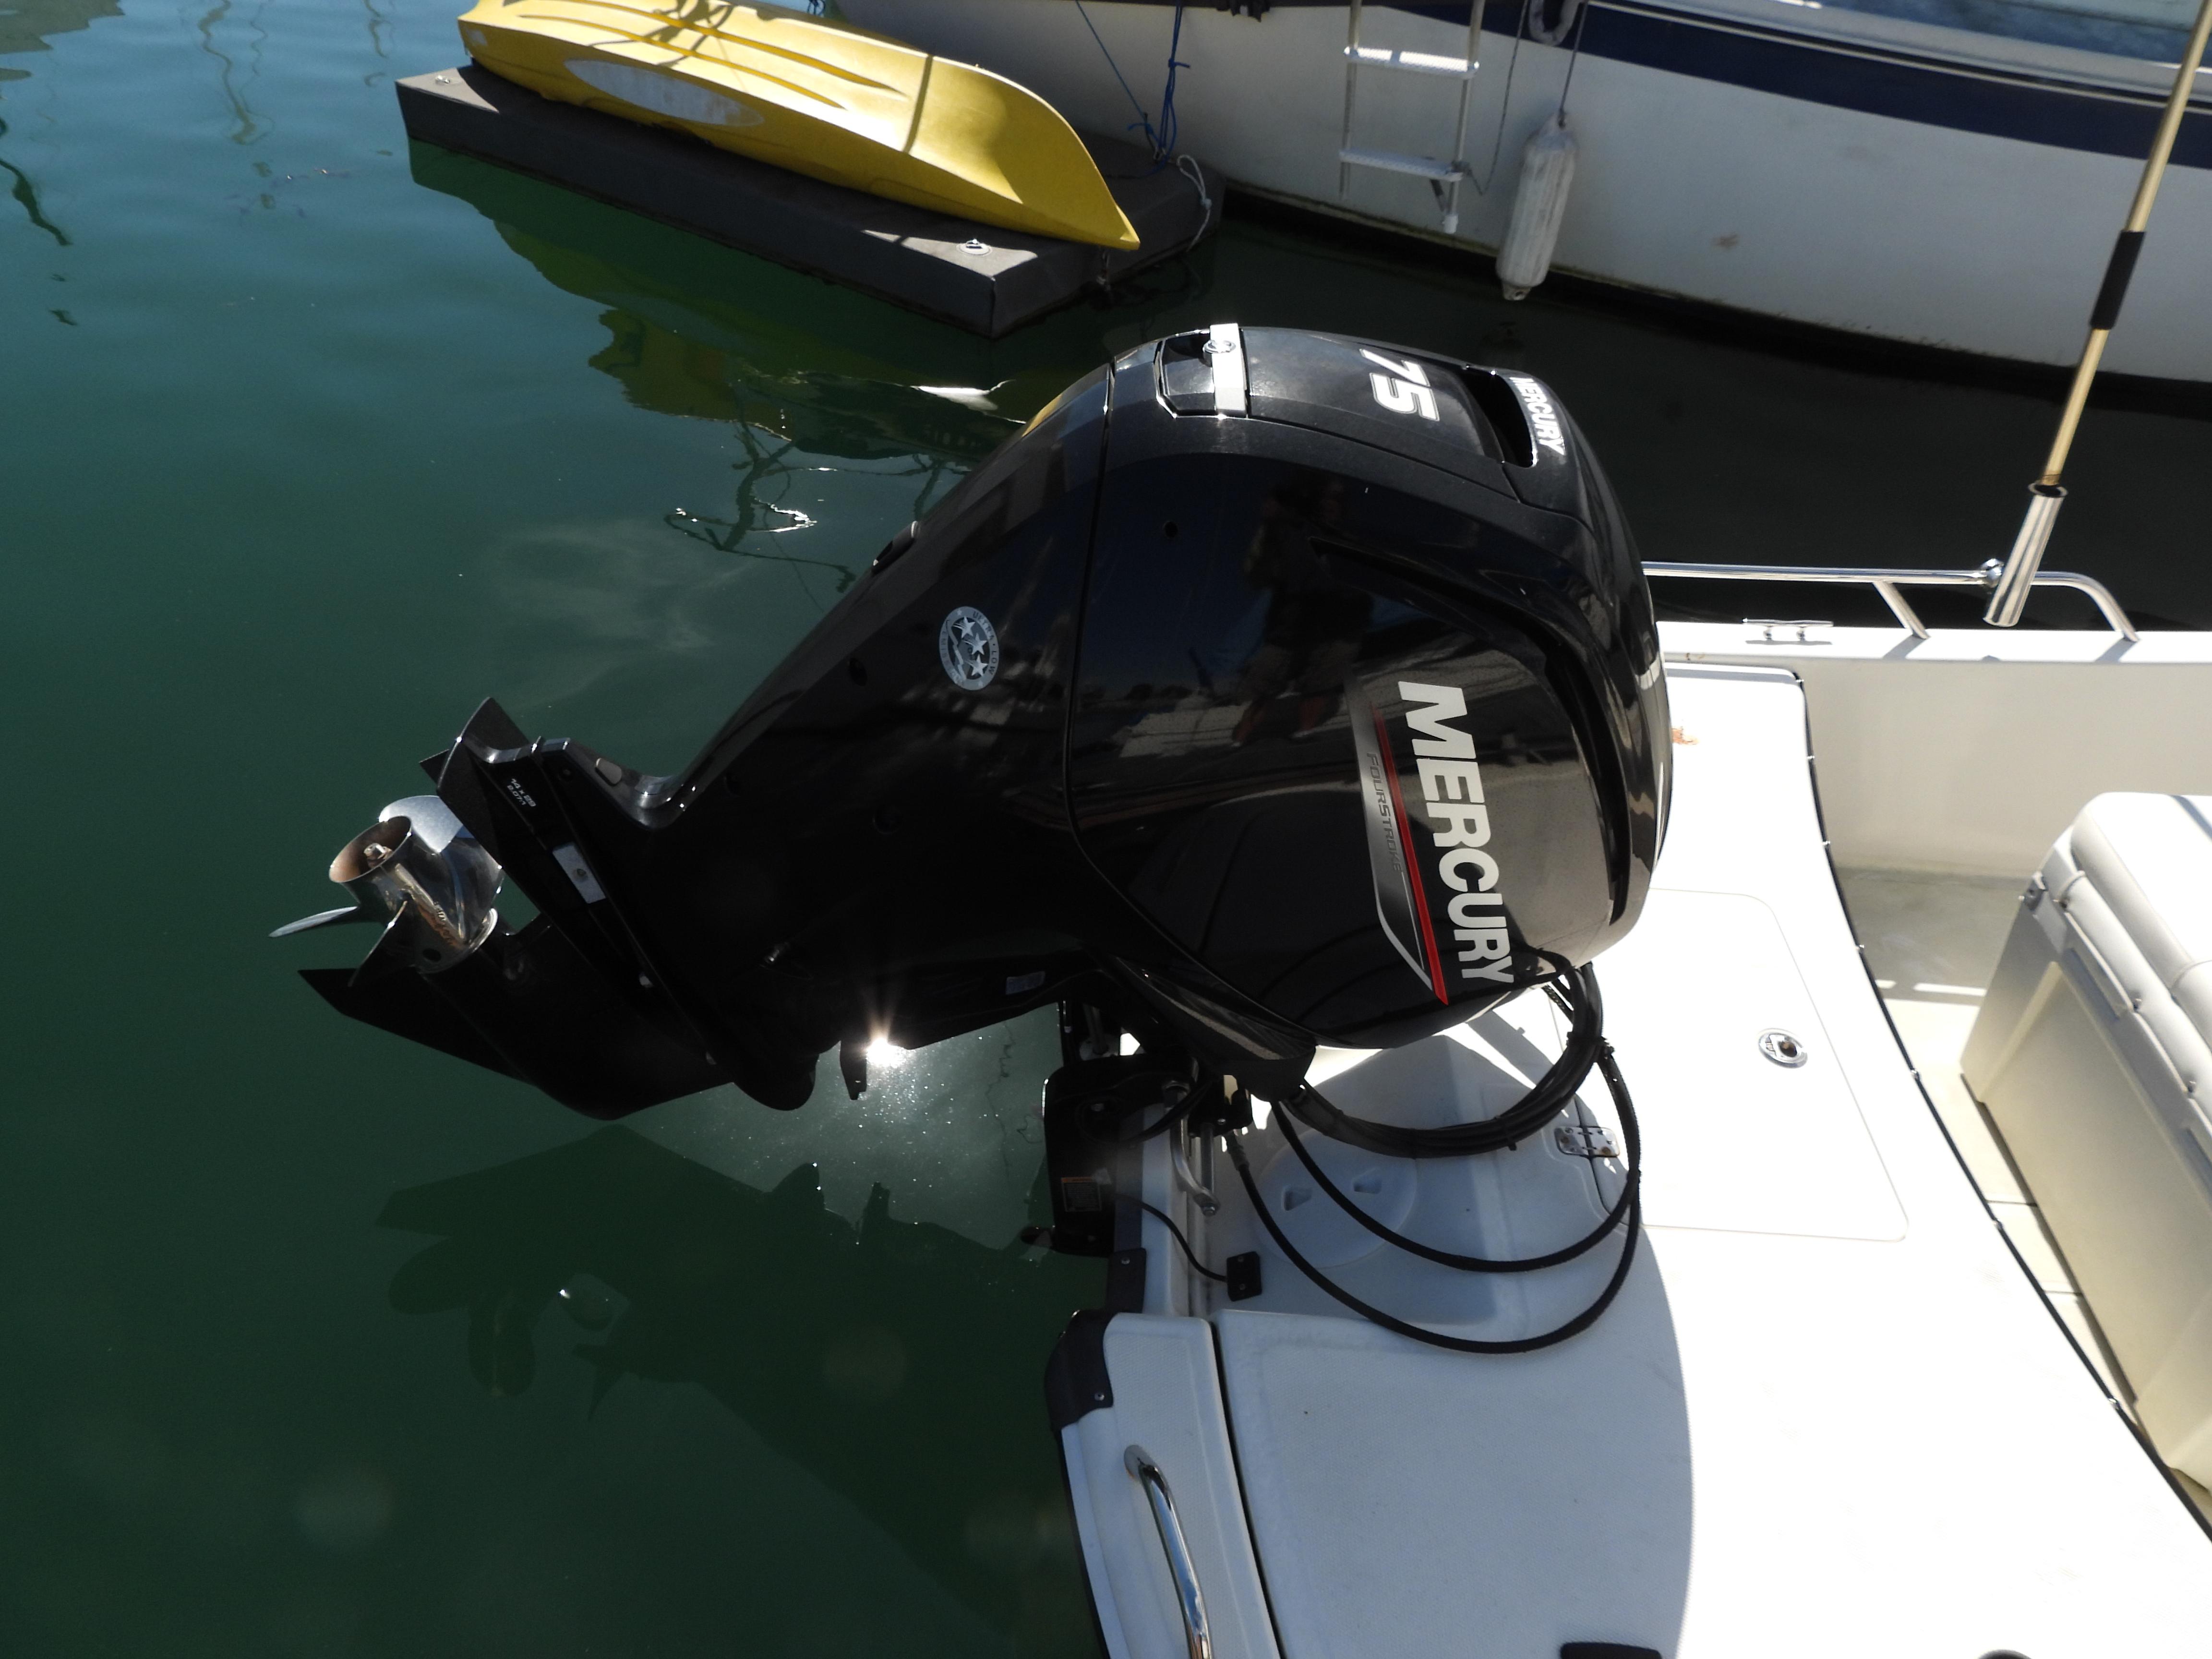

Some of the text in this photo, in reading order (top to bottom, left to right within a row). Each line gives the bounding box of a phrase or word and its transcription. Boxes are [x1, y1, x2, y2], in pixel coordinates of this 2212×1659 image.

[1359, 349, 1440, 421] 75
[1509, 377, 1565, 455] MERCURY
[988, 650, 998, 675] LOW
[1367, 752, 1402, 871] FOURSTROKE
[1398, 681, 1514, 983] MERCURY
